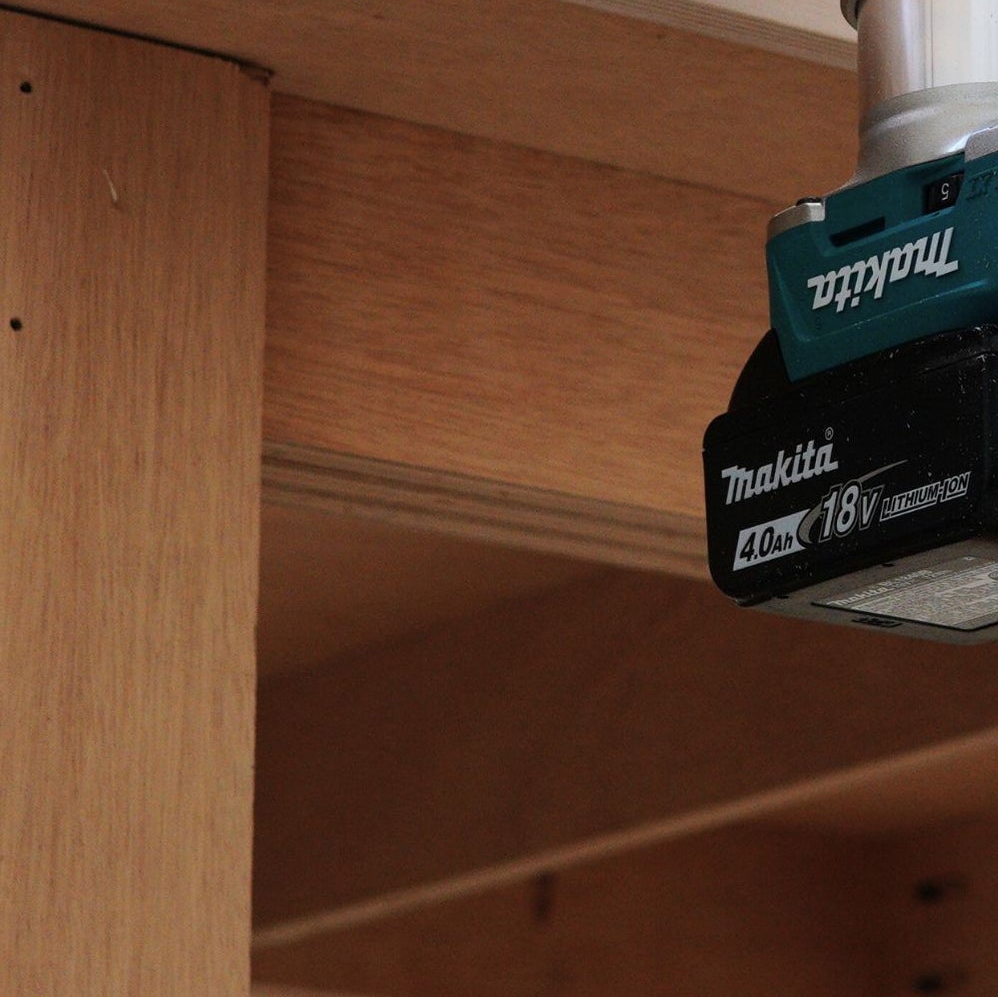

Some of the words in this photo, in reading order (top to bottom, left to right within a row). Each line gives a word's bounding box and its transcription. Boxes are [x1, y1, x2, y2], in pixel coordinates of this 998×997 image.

[940, 182, 950, 201] 5
[739, 526, 794, 563] 4.0Ah
[819, 480, 884, 542] 18V
[880, 471, 972, 522] LITHIUM-ION
